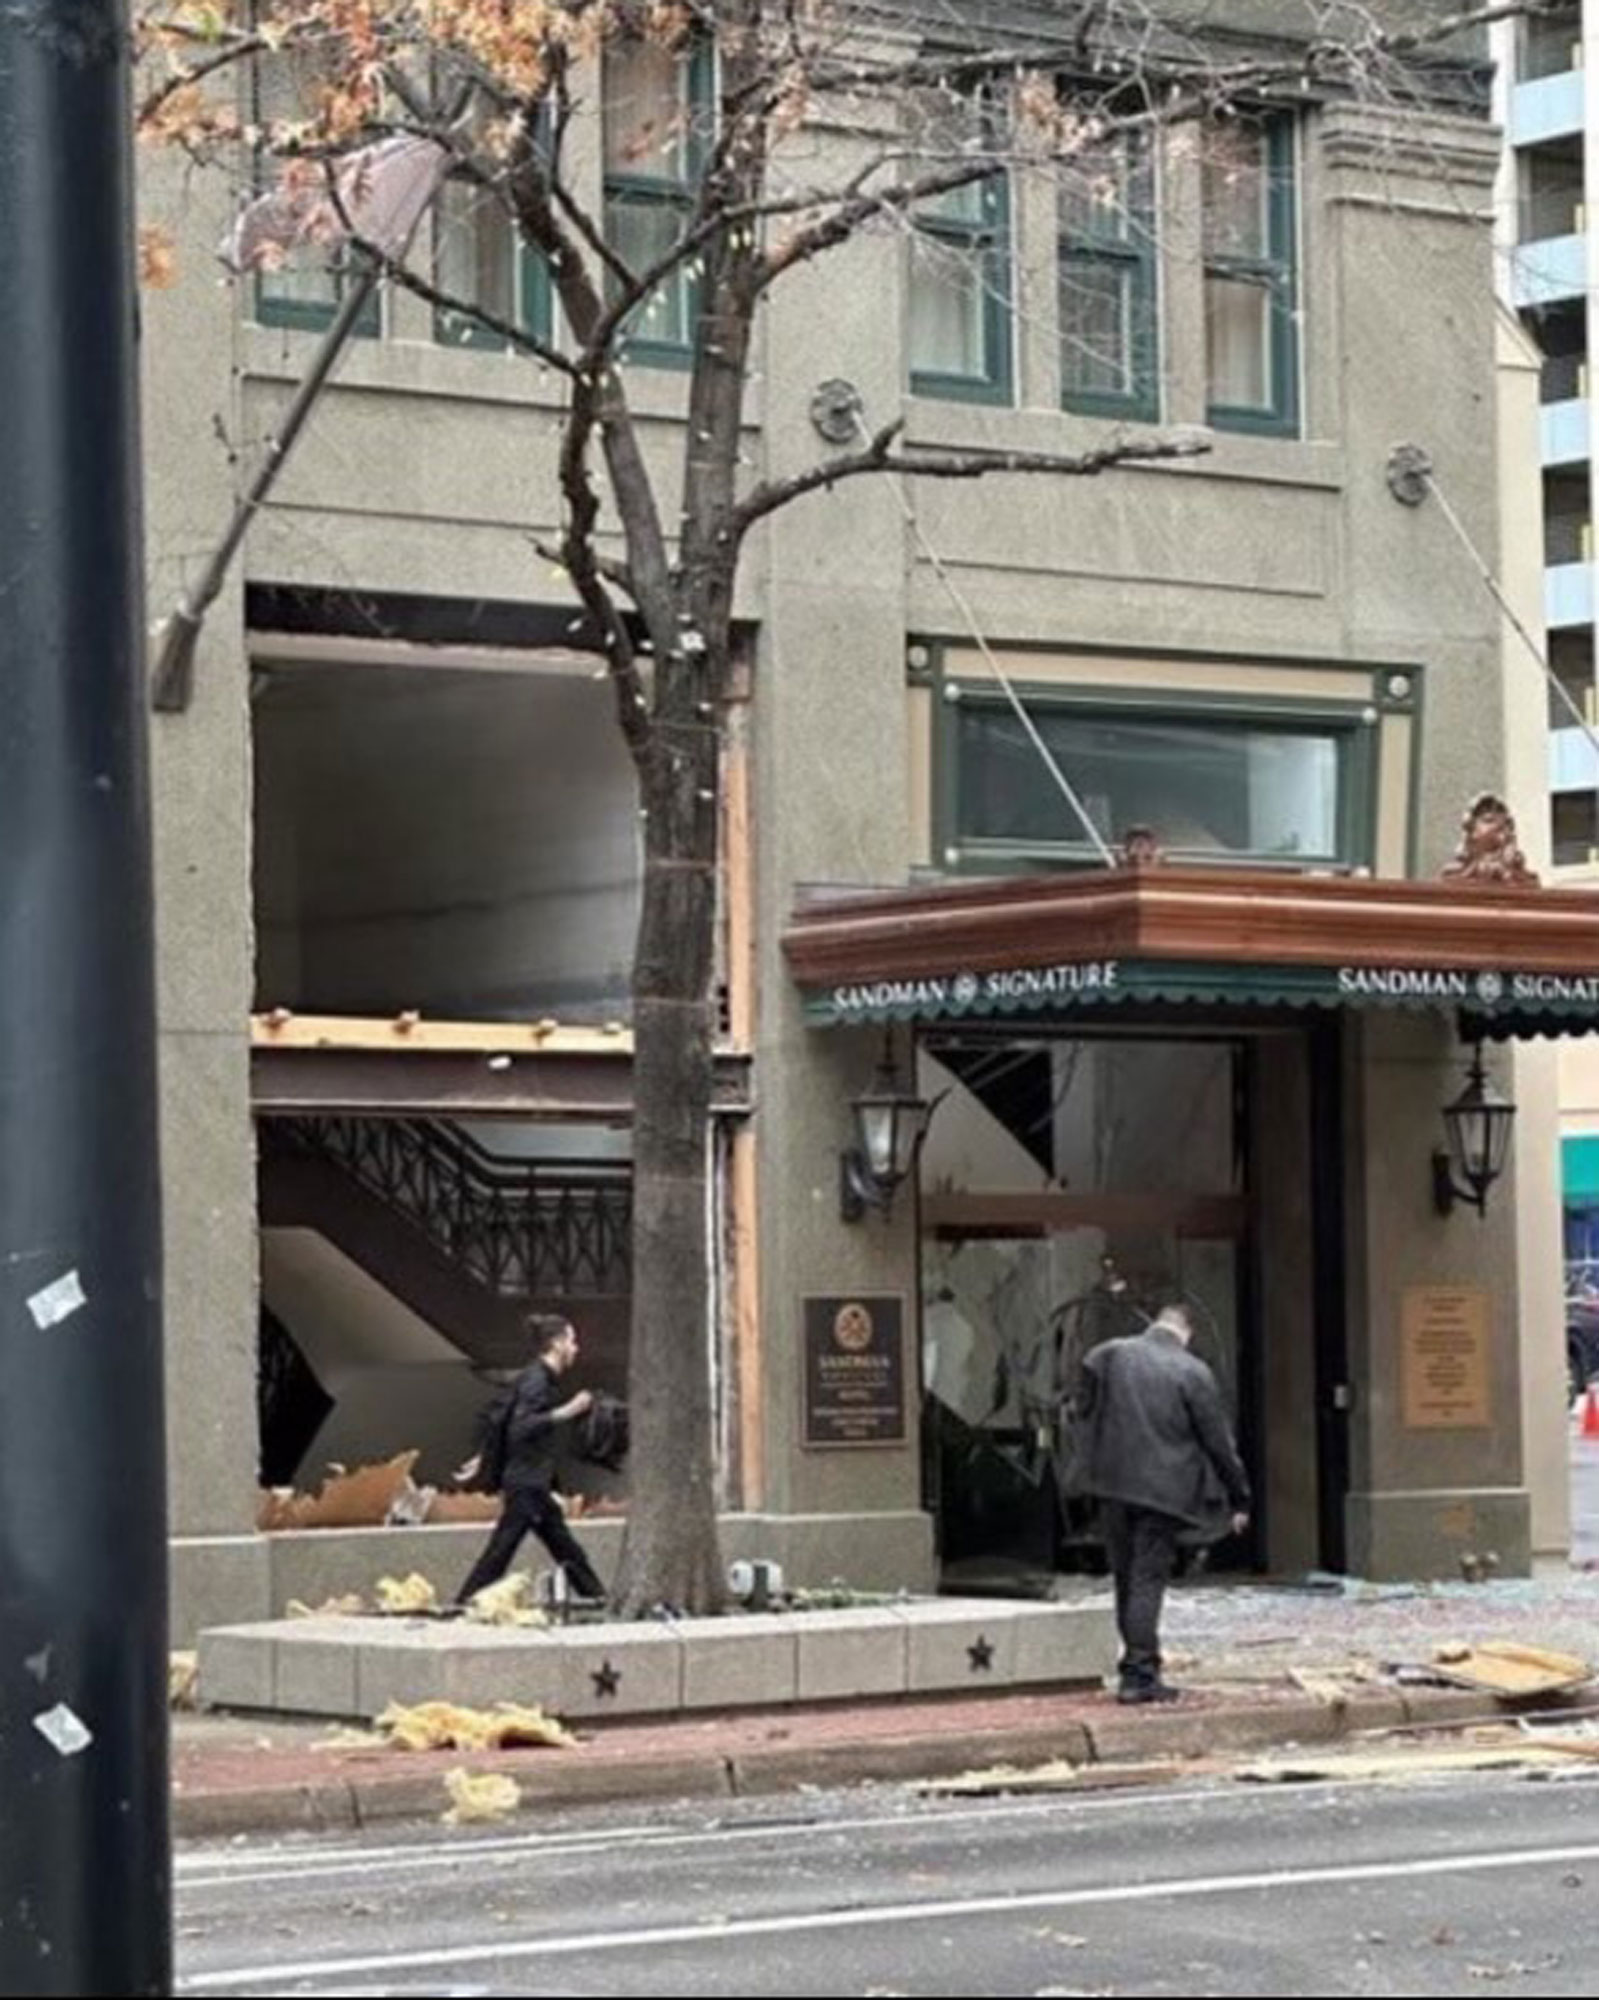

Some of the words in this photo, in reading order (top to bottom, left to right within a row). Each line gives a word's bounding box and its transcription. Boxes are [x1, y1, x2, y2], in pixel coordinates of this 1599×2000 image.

[832, 979, 948, 1010] SANDMAN
[985, 961, 1119, 997] SIGNATURE
[1337, 967, 1467, 996] SANDMAN
